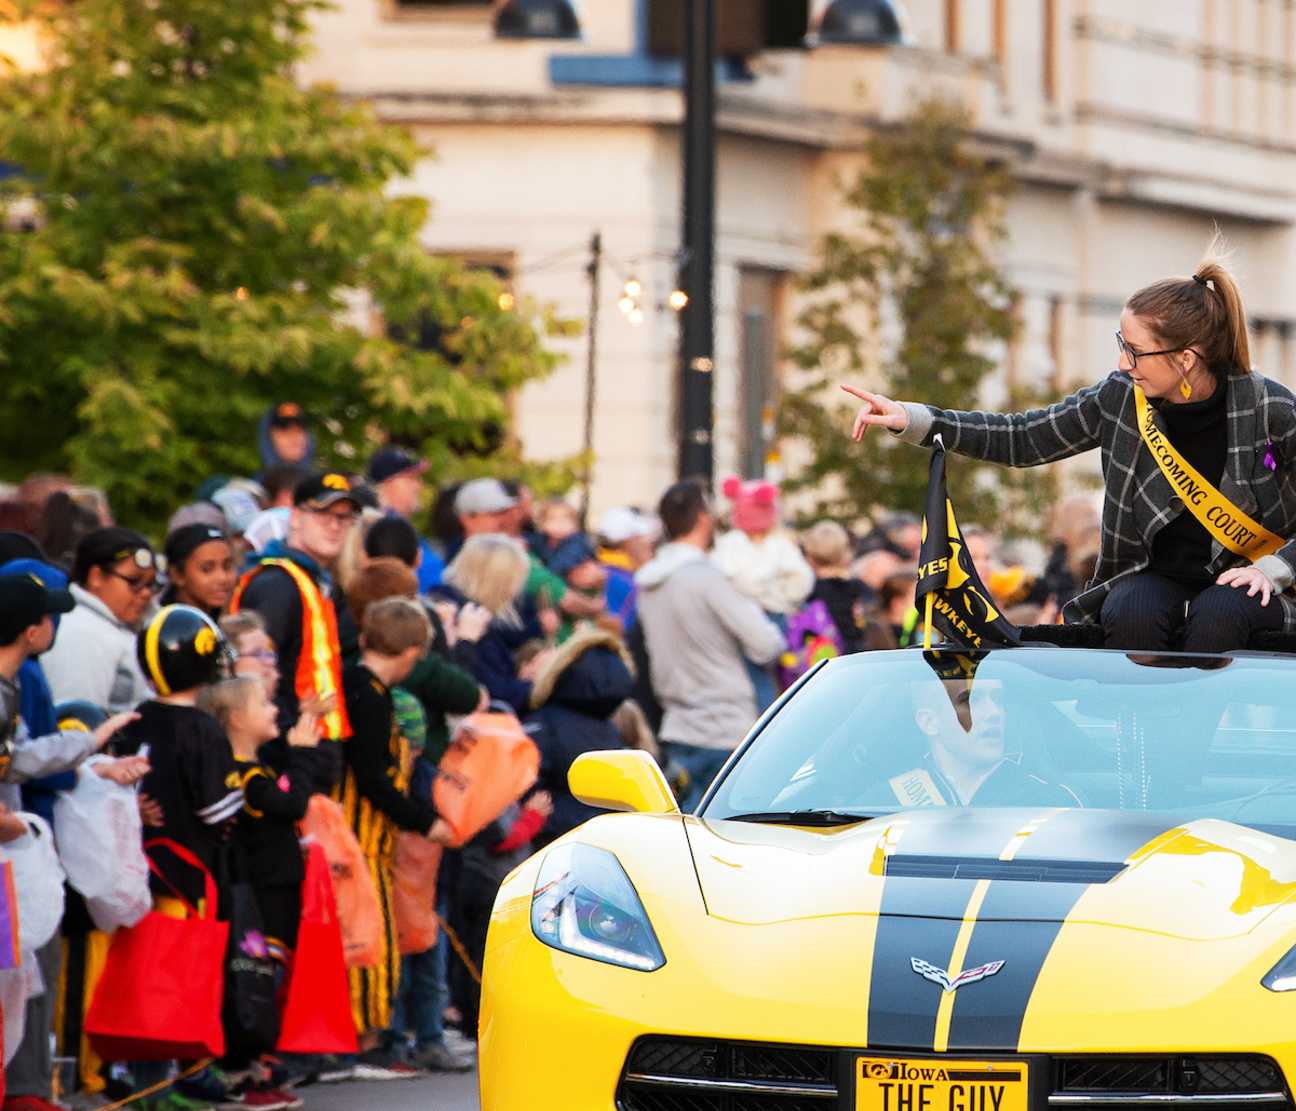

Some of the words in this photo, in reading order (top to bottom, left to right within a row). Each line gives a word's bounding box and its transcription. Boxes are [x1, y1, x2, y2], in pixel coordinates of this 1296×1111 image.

[1206, 506, 1258, 548] COURT
[902, 774, 935, 806] HOM
[878, 1083, 934, 1111] THE
[949, 1084, 1005, 1111] GUY
